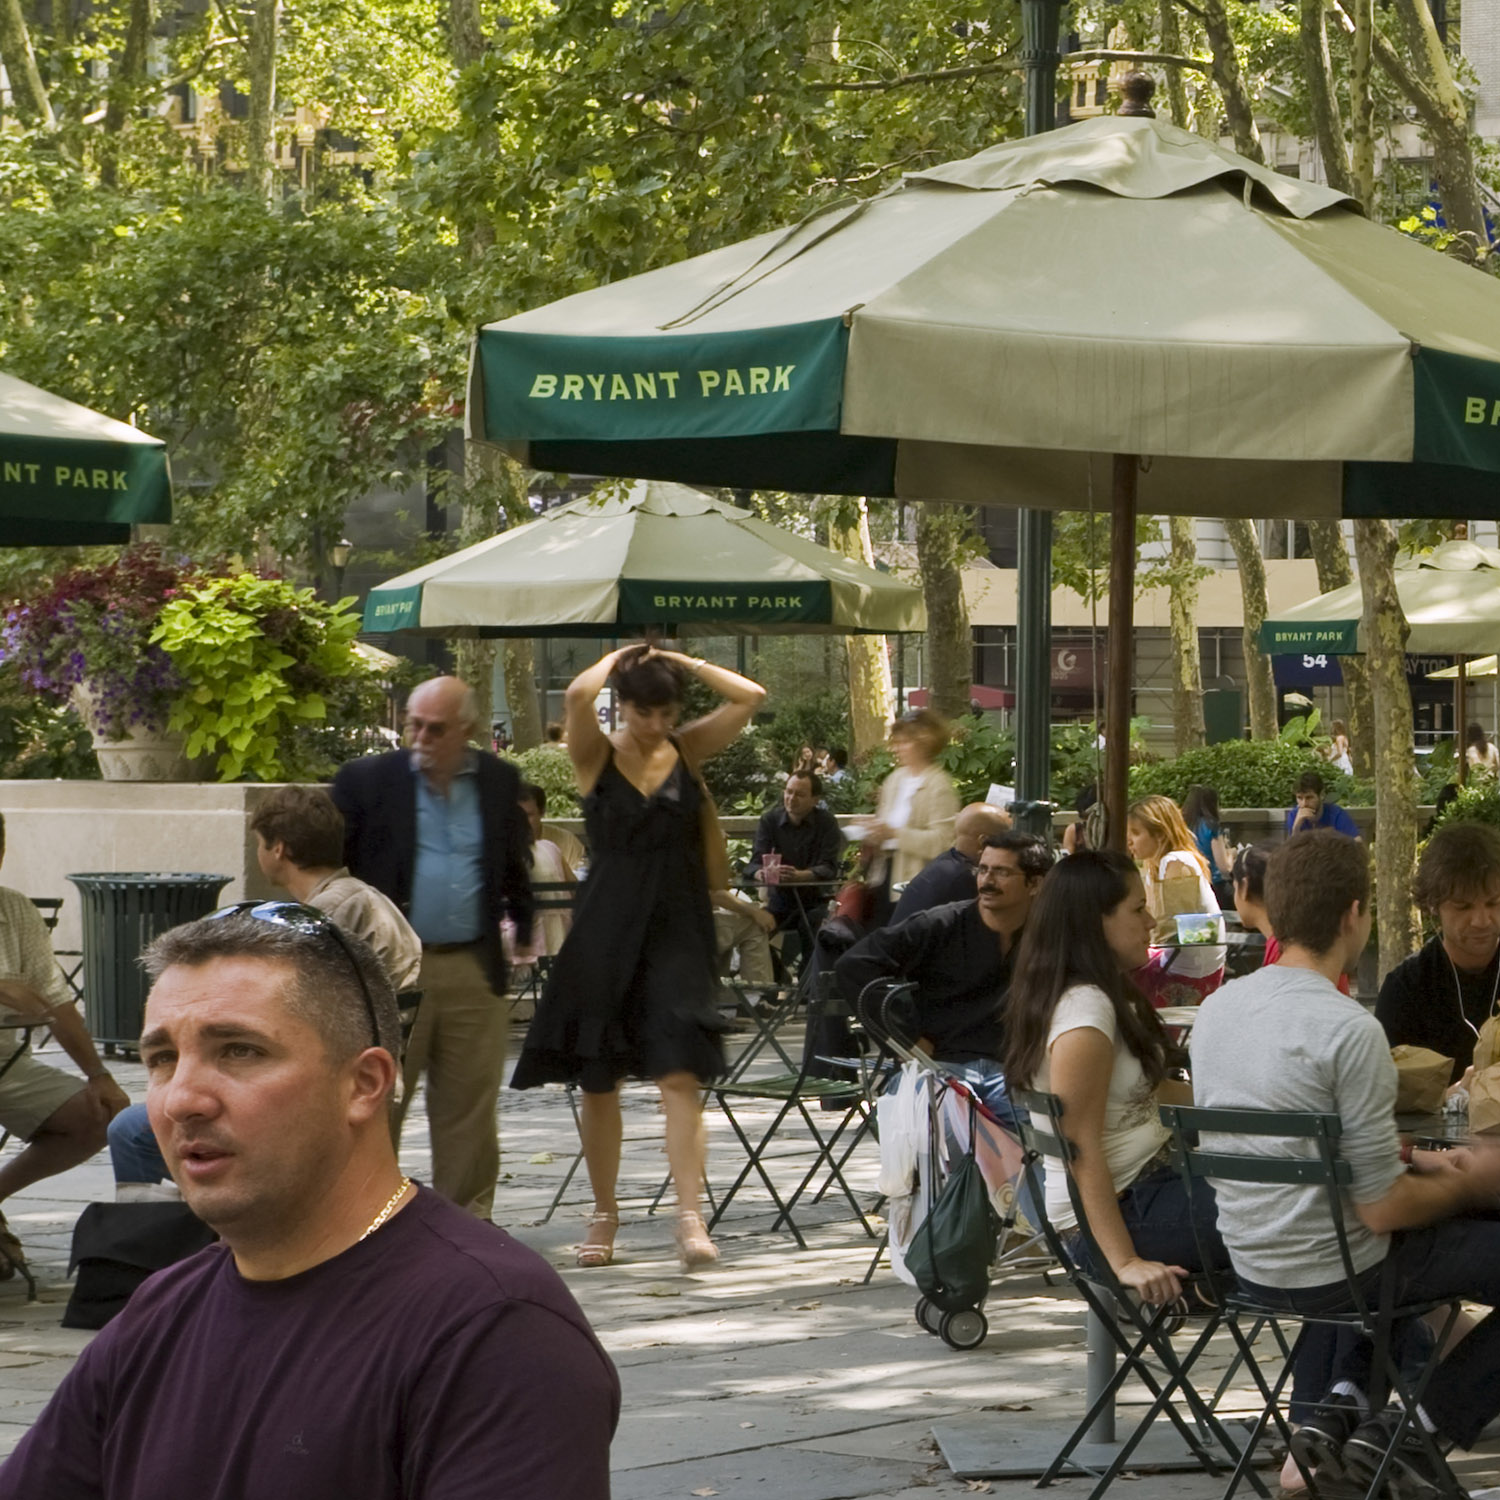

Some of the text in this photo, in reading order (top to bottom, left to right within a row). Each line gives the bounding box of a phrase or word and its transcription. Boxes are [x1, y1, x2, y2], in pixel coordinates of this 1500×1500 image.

[529, 365, 796, 400] BRYANT PARK
[55, 466, 128, 491] PARK
[654, 596, 803, 608] BRYANT PARK
[1275, 631, 1344, 642] BRYANT PARK
[1302, 654, 1328, 669] 54
